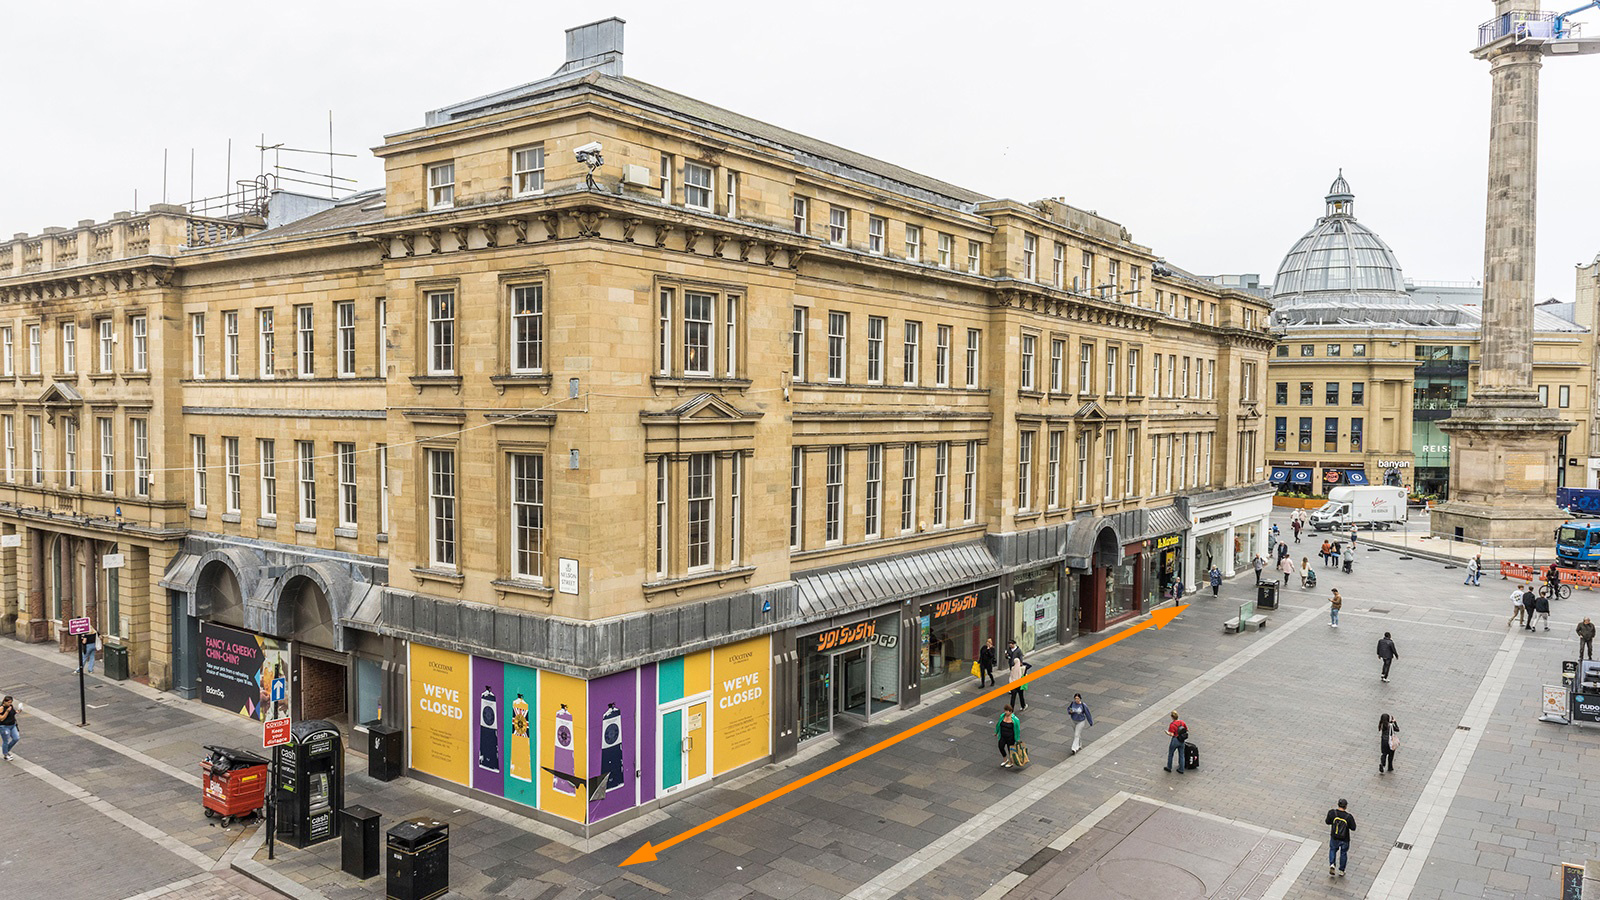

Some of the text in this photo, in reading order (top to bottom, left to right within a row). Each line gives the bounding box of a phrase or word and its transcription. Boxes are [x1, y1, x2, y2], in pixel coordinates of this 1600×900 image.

[1378, 460, 1410, 468] banyan
[206, 636, 257, 658] FANCY A CHEEKY
[206, 648, 240, 665] CHIN-CHIN?
[723, 672, 759, 692] WE'VE
[720, 687, 762, 709] CLOSED
[420, 698, 462, 720] CLOSED
[266, 720, 289, 729] COVID-19
[313, 732, 328, 740] cash
[281, 749, 296, 760] cash
[312, 814, 328, 824] cash
